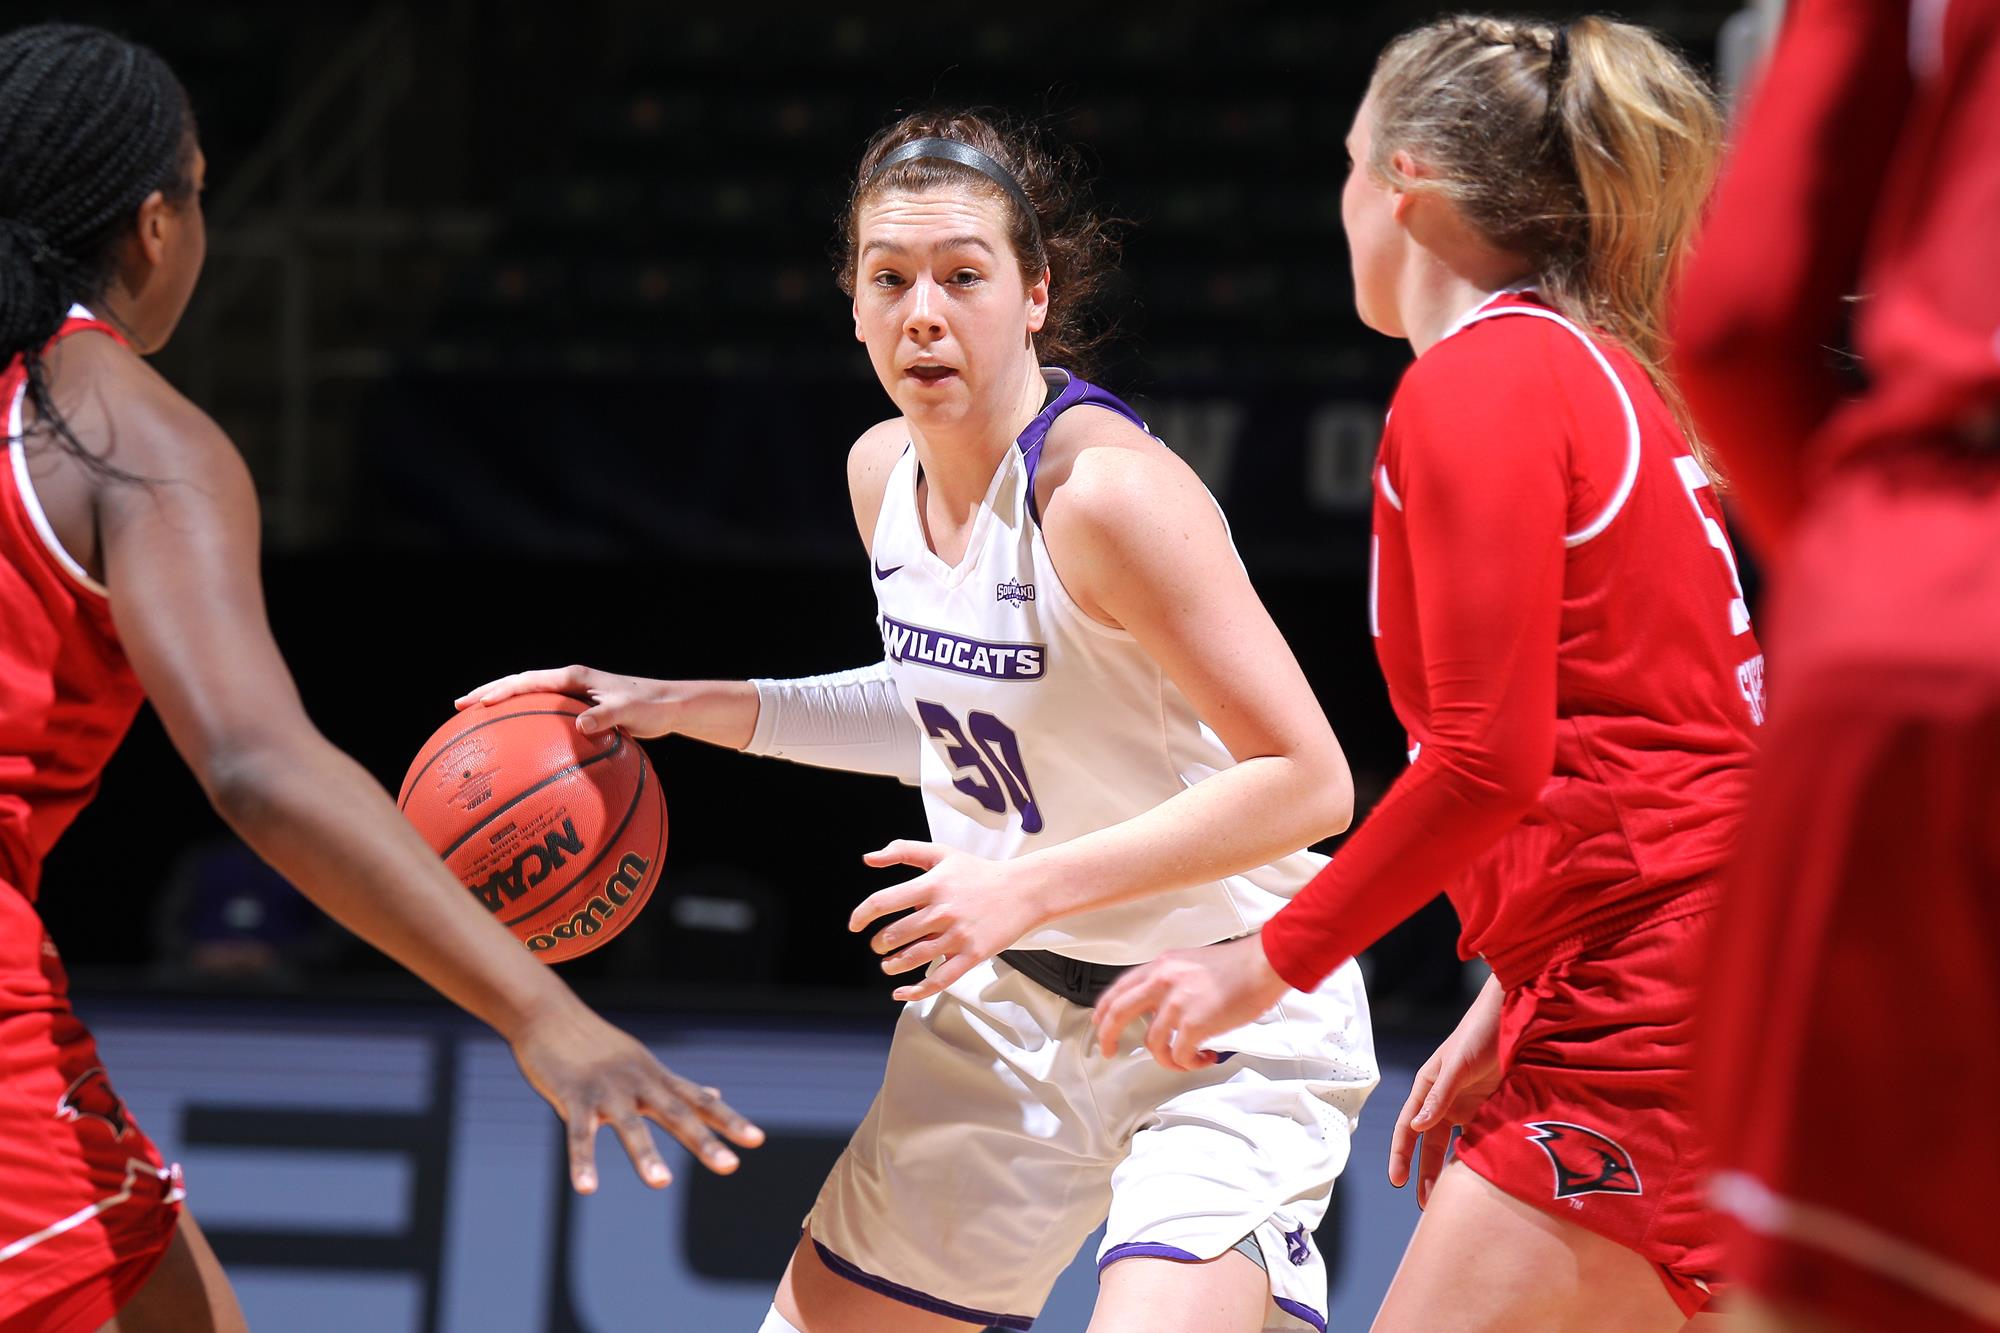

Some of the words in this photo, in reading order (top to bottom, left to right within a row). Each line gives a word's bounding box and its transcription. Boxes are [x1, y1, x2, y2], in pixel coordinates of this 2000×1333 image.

[884, 620, 1041, 676] WILDCATS
[914, 697, 1044, 834] 30
[468, 817, 585, 914] NCAA
[526, 851, 650, 953] Wilso
